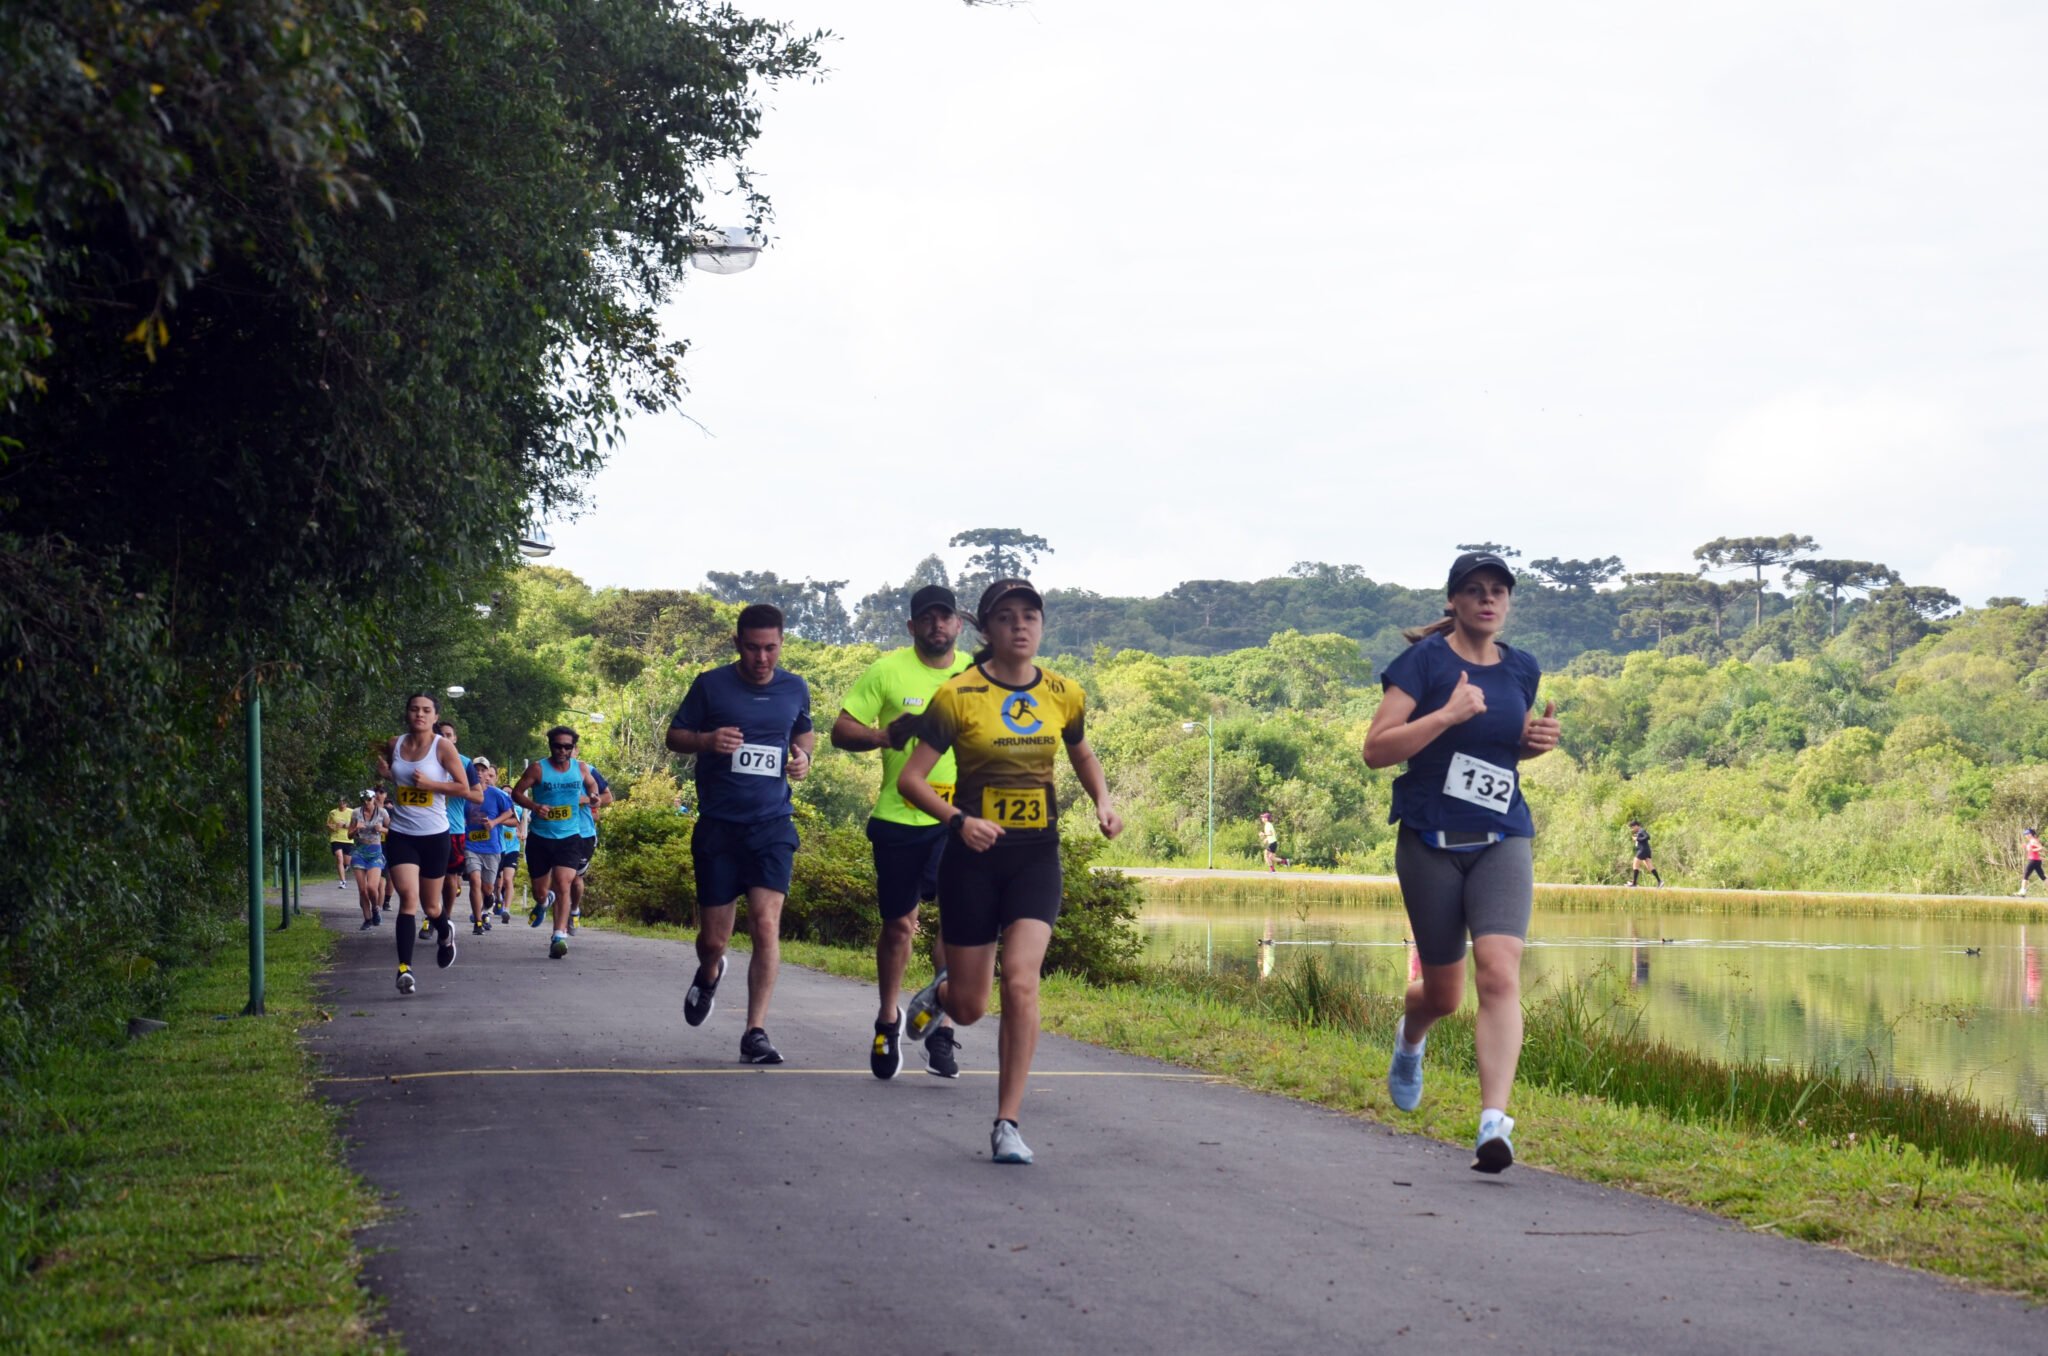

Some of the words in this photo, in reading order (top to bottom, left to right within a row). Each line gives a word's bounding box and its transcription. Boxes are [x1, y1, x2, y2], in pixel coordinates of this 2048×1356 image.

[739, 751, 776, 770] 078
[1462, 768, 1511, 804] 132
[401, 791, 428, 804] 125
[548, 809, 568, 819] 058
[993, 798, 1041, 821] 123
